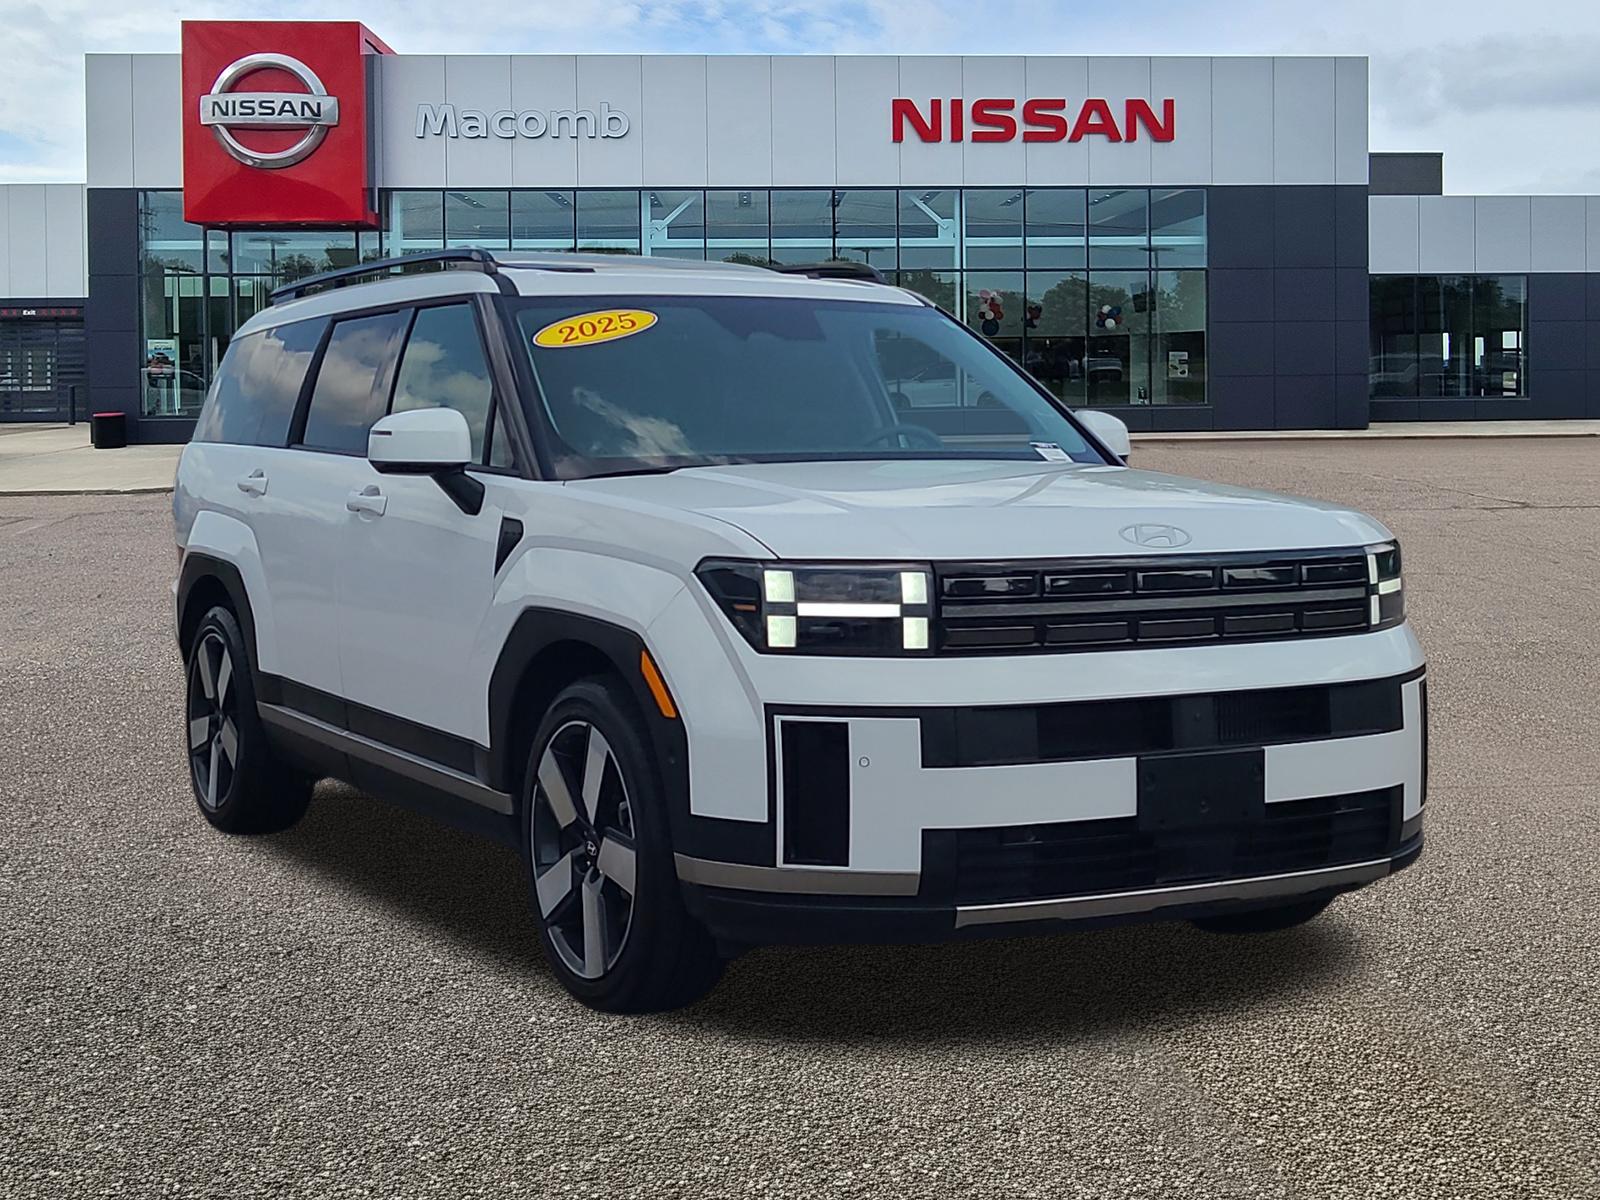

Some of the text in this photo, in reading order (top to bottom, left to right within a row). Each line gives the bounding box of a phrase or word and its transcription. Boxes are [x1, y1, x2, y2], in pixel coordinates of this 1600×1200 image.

[212, 100, 322, 117] NISSAN
[415, 102, 630, 138] Macomb
[892, 98, 1175, 142] NISSAN
[558, 313, 637, 343] 2025
